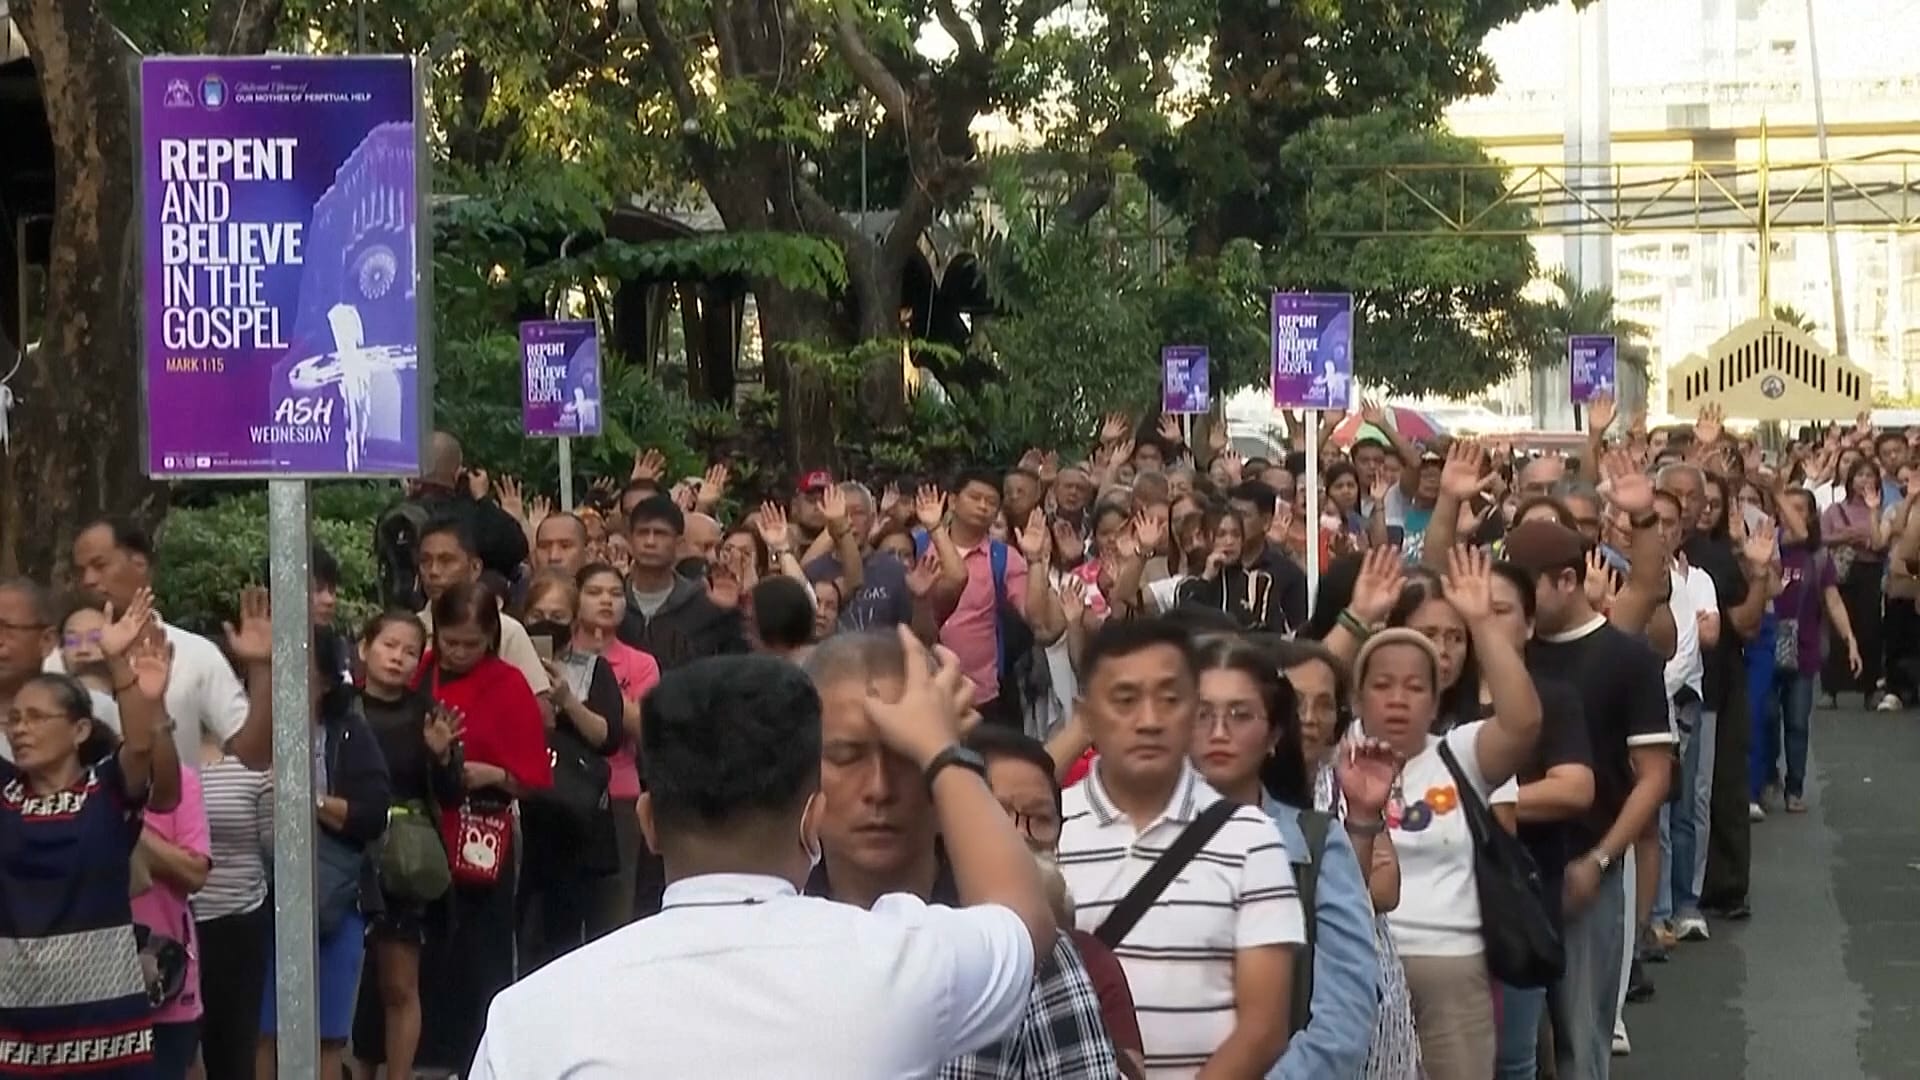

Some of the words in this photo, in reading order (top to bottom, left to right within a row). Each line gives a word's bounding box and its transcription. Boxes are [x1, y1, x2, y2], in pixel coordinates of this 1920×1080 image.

[235, 92, 253, 103] OUR
[255, 92, 290, 102] MOTHER
[291, 92, 302, 102] OF
[305, 91, 350, 102] PERPETUAL
[351, 91, 372, 101] HELP
[161, 138, 298, 181] REPENT
[161, 182, 230, 223] AND
[162, 222, 303, 265] BELIEVE
[163, 265, 195, 307] IN
[204, 265, 266, 307] THE
[163, 306, 289, 349] GOSPEL
[1278, 314, 1318, 328] REPENT
[526, 342, 566, 356] REPENT
[166, 357, 199, 373] MARK
[202, 357, 225, 372] 1:15
[527, 366, 568, 379] BELIEVE
[274, 397, 334, 425] ASH
[250, 426, 332, 444] WEDNESDAY
